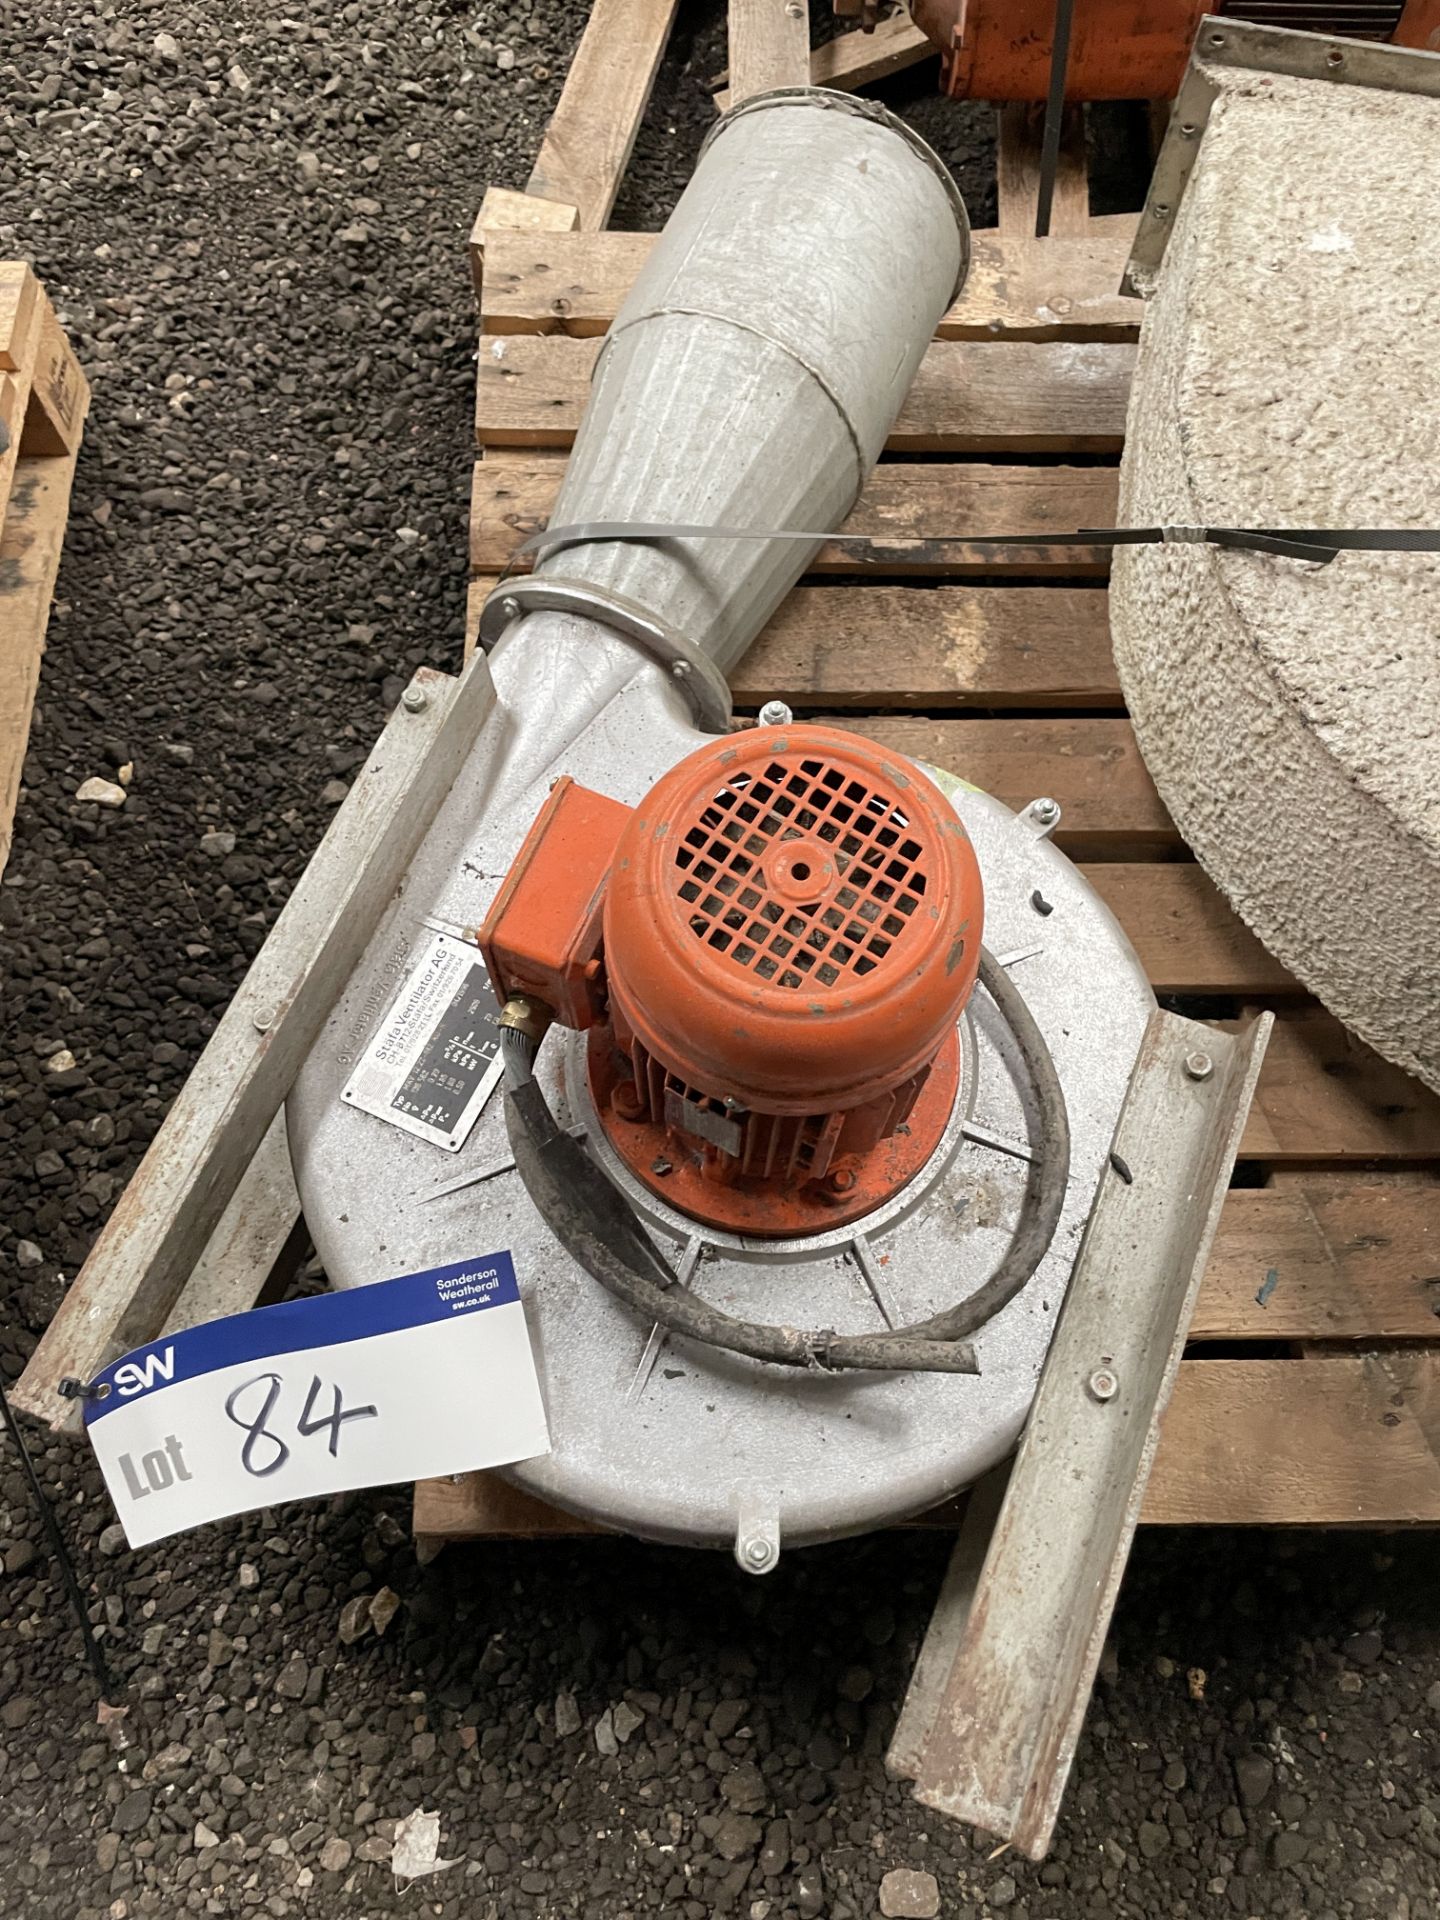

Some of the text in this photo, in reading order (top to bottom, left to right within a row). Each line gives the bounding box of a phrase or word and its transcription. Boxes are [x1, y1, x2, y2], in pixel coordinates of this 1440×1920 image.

[374, 1024, 402, 1061] Stäfa
[394, 966, 437, 1028] Ventilator
[429, 946, 448, 969] AG
[392, 1093, 406, 1109] Typ
[436, 1267, 497, 1290] Sanderson
[438, 1278, 499, 1301] Weatherall
[452, 1294, 491, 1310] sw.co.uk
[113, 1345, 176, 1396] SW
[225, 1372, 379, 1478] 84
[117, 1434, 193, 1500] Lot
